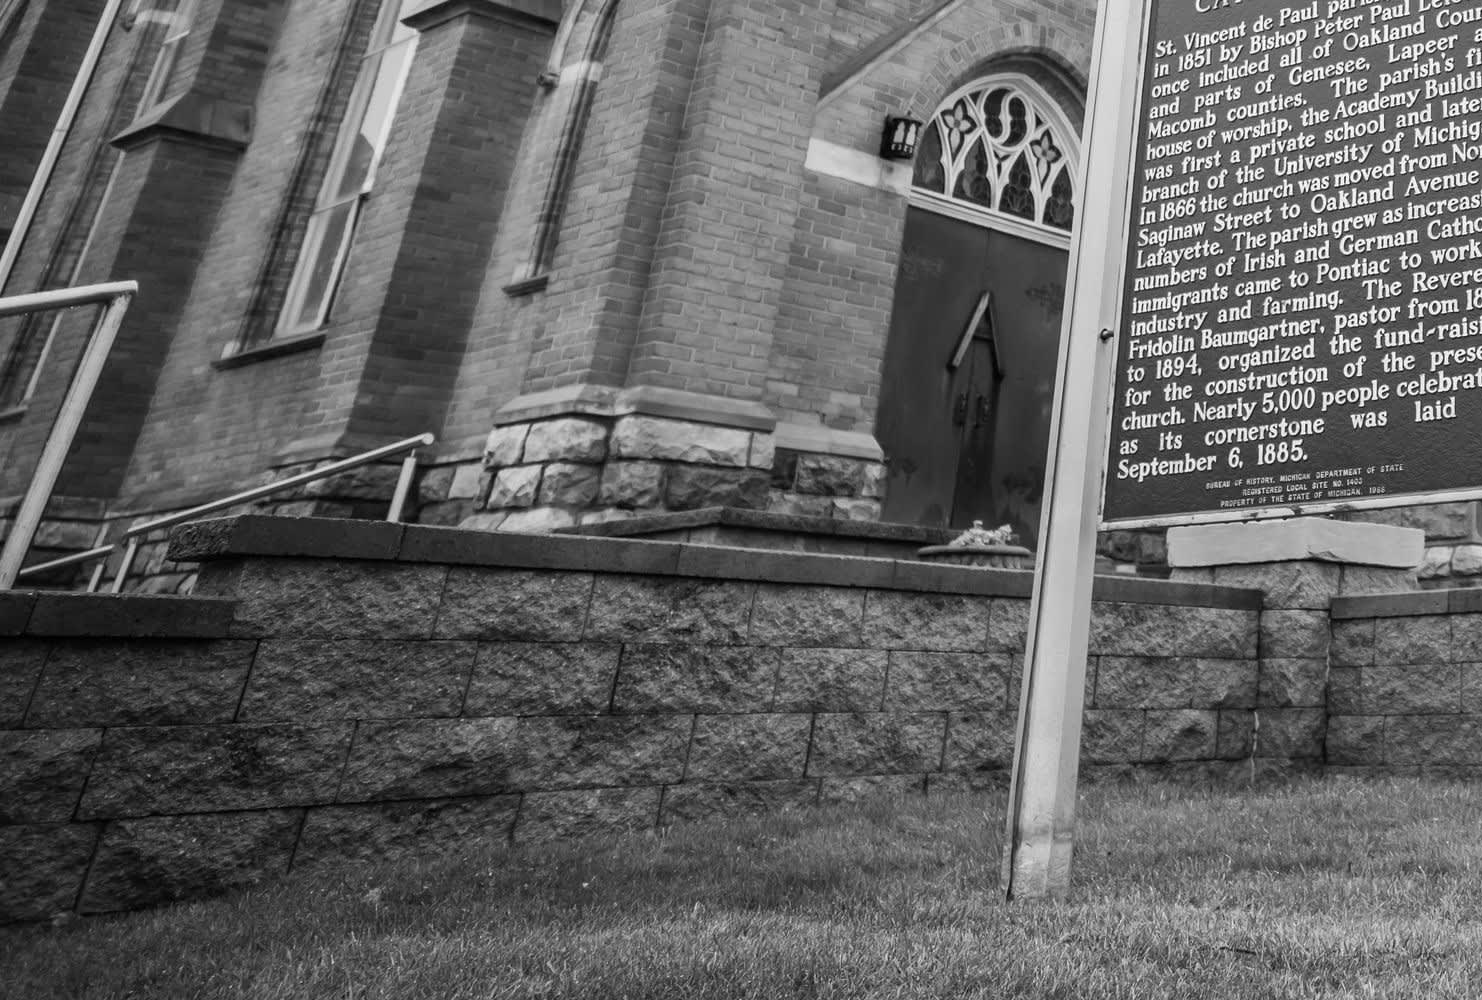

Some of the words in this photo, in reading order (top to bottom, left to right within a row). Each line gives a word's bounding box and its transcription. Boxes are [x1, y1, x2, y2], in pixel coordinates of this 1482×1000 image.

[1151, 78, 1190, 98] once
[1198, 53, 1270, 88] included
[1279, 45, 1303, 68] all
[1308, 38, 1334, 59] of
[1342, 14, 1426, 51] Oakland
[1153, 62, 1169, 78] in
[1177, 47, 1212, 72] 1851
[1218, 43, 1244, 63] by
[1248, 28, 1308, 55] Bishop
[1313, 14, 1364, 39] Peter
[1154, 39, 1177, 58] St.
[1183, 20, 1247, 51] Vincent
[1252, 14, 1274, 33] de
[1278, 0, 1319, 27] Paul
[1147, 108, 1217, 140] Macomb
[1226, 92, 1308, 122] counties.
[1329, 76, 1368, 98] The
[1379, 57, 1455, 92] parish's
[1149, 95, 1180, 120] and
[1193, 84, 1242, 113] parts
[1254, 73, 1276, 94] of
[1288, 56, 1371, 86] Genesee,
[1387, 34, 1458, 64] Lapeer
[1144, 163, 1173, 181] was
[1181, 150, 1222, 175] first
[1229, 149, 1241, 164] a
[1249, 131, 1316, 165] private
[1324, 113, 1386, 144] school
[1395, 102, 1433, 129] and
[1146, 139, 1193, 161] house
[1196, 129, 1217, 150] of
[1220, 116, 1293, 144] worship,
[1299, 106, 1330, 127] the
[1332, 88, 1421, 121] Academy
[1139, 206, 1156, 226] In
[1159, 196, 1197, 222] 1866
[1199, 193, 1228, 213] the
[1232, 178, 1294, 207] church
[1297, 175, 1330, 194] was
[1333, 156, 1395, 187] moved
[1398, 152, 1448, 175] from
[1141, 175, 1200, 204] branch
[1206, 168, 1229, 190] of
[1235, 164, 1265, 185] the
[1274, 143, 1374, 177] University
[1381, 131, 1405, 154] of
[1136, 239, 1224, 269] Lafayette.
[1231, 231, 1267, 252] The
[1269, 217, 1329, 251] parish
[1331, 212, 1378, 239] grew
[1382, 207, 1404, 225] as
[1137, 221, 1206, 248] Saginaw
[1213, 204, 1273, 233] Street
[1279, 202, 1301, 220] to
[1310, 180, 1394, 214] Oakland
[1404, 170, 1480, 197] Avenue
[1131, 282, 1229, 314] immigrants
[1234, 276, 1282, 297] came
[1288, 269, 1309, 288] to
[1315, 257, 1390, 284] Pontiac
[1398, 250, 1422, 270] to
[1133, 266, 1207, 292] numbers
[1214, 256, 1236, 277] of
[1243, 248, 1286, 273] Irish
[1294, 239, 1330, 264] and
[1339, 229, 1419, 256] German
[1129, 334, 1195, 359] Fridolin
[1200, 318, 1325, 350] Baumgartner,
[1333, 304, 1401, 335] pastor
[1407, 297, 1460, 319] from
[1130, 311, 1208, 337] industry
[1216, 299, 1252, 323] and
[1262, 290, 1344, 317] farming.
[1361, 278, 1402, 300] The
[1125, 387, 1152, 407] for
[1163, 382, 1193, 402] the
[1204, 365, 1329, 396] construction
[1343, 355, 1367, 378] of
[1381, 351, 1416, 373] the
[1126, 365, 1145, 383] to
[1156, 353, 1202, 379] 1894,
[1218, 337, 1315, 373] organized
[1328, 334, 1362, 356] the
[1119, 439, 1138, 455] as
[1159, 431, 1183, 451] its
[1204, 417, 1325, 446] cornerstone
[1350, 410, 1388, 429] was
[1414, 396, 1457, 422] laid
[1121, 406, 1186, 431] church.
[1193, 397, 1257, 423] Nearly
[1262, 386, 1316, 414] 5,000
[1321, 379, 1390, 412] people
[1117, 452, 1217, 483] September
[1228, 446, 1244, 469] 6,
[1257, 438, 1308, 465] 1885.
